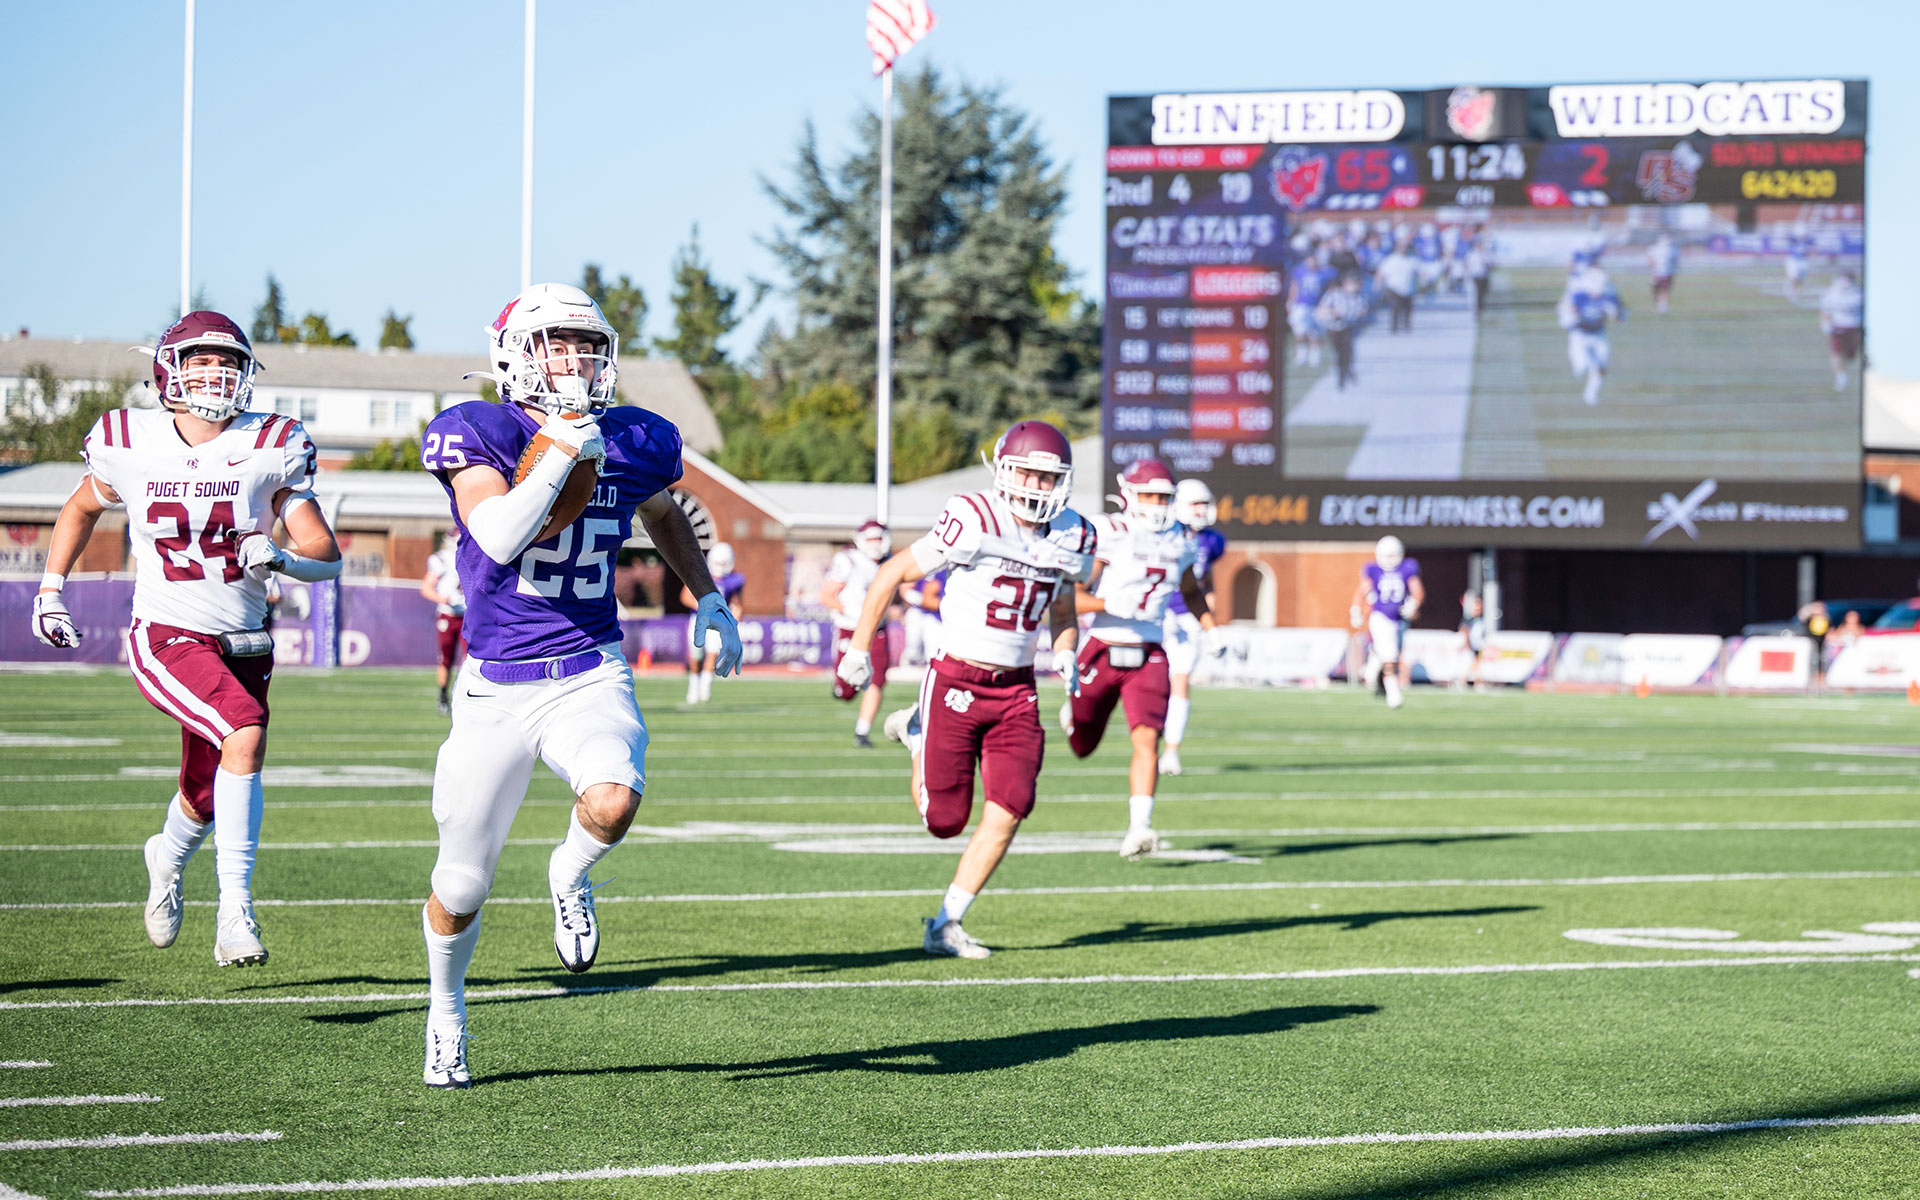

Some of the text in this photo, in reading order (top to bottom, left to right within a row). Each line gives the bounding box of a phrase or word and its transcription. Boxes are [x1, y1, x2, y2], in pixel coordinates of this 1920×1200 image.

[1160, 89, 1836, 134] LINFIELD WILDCATS
[1335, 150, 1390, 190] 65
[1427, 144, 1526, 181] 11:24
[1579, 144, 1609, 187] 2
[1168, 172, 1191, 205] 4
[1112, 214, 1274, 248] CAT STATS
[422, 433, 468, 470] 25
[146, 480, 240, 497] PUGET SOUND
[1217, 495, 1309, 524] 4-5044
[1319, 495, 1604, 527] EXCELLFITNESS.COM
[147, 501, 245, 583] 24
[516, 517, 620, 599] 25
[986, 575, 1056, 631] 20
[1138, 567, 1166, 610] 7
